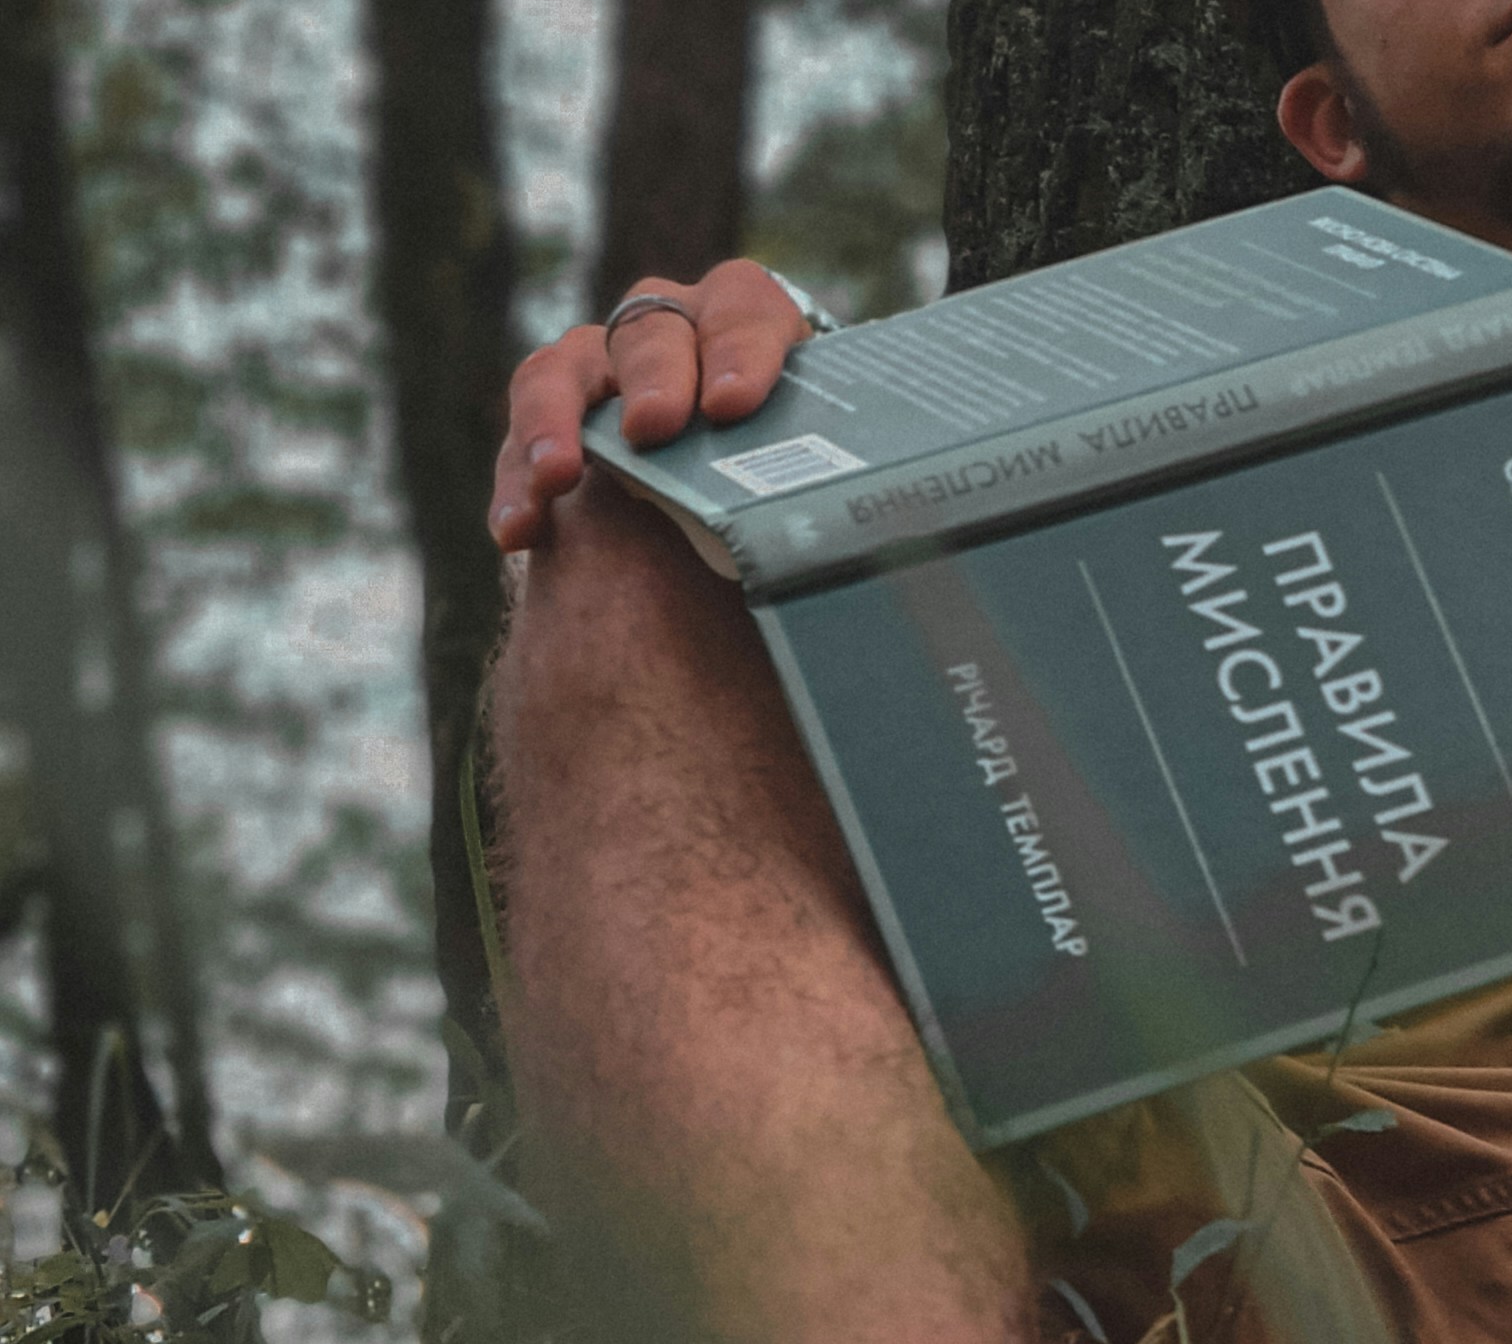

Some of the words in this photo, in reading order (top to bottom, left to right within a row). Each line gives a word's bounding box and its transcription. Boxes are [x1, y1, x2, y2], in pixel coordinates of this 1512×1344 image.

[844, 440, 1063, 526] МИСЛЕННЯ
[1078, 383, 1260, 452] ПРАВИЛА
[946, 662, 1018, 787] РІЧАРД
[1001, 794, 1088, 959] ТЕМПЛАР
[1161, 529, 1383, 943] МИСЛЕННЯ
[1262, 530, 1449, 884] ПРАВИЛА
